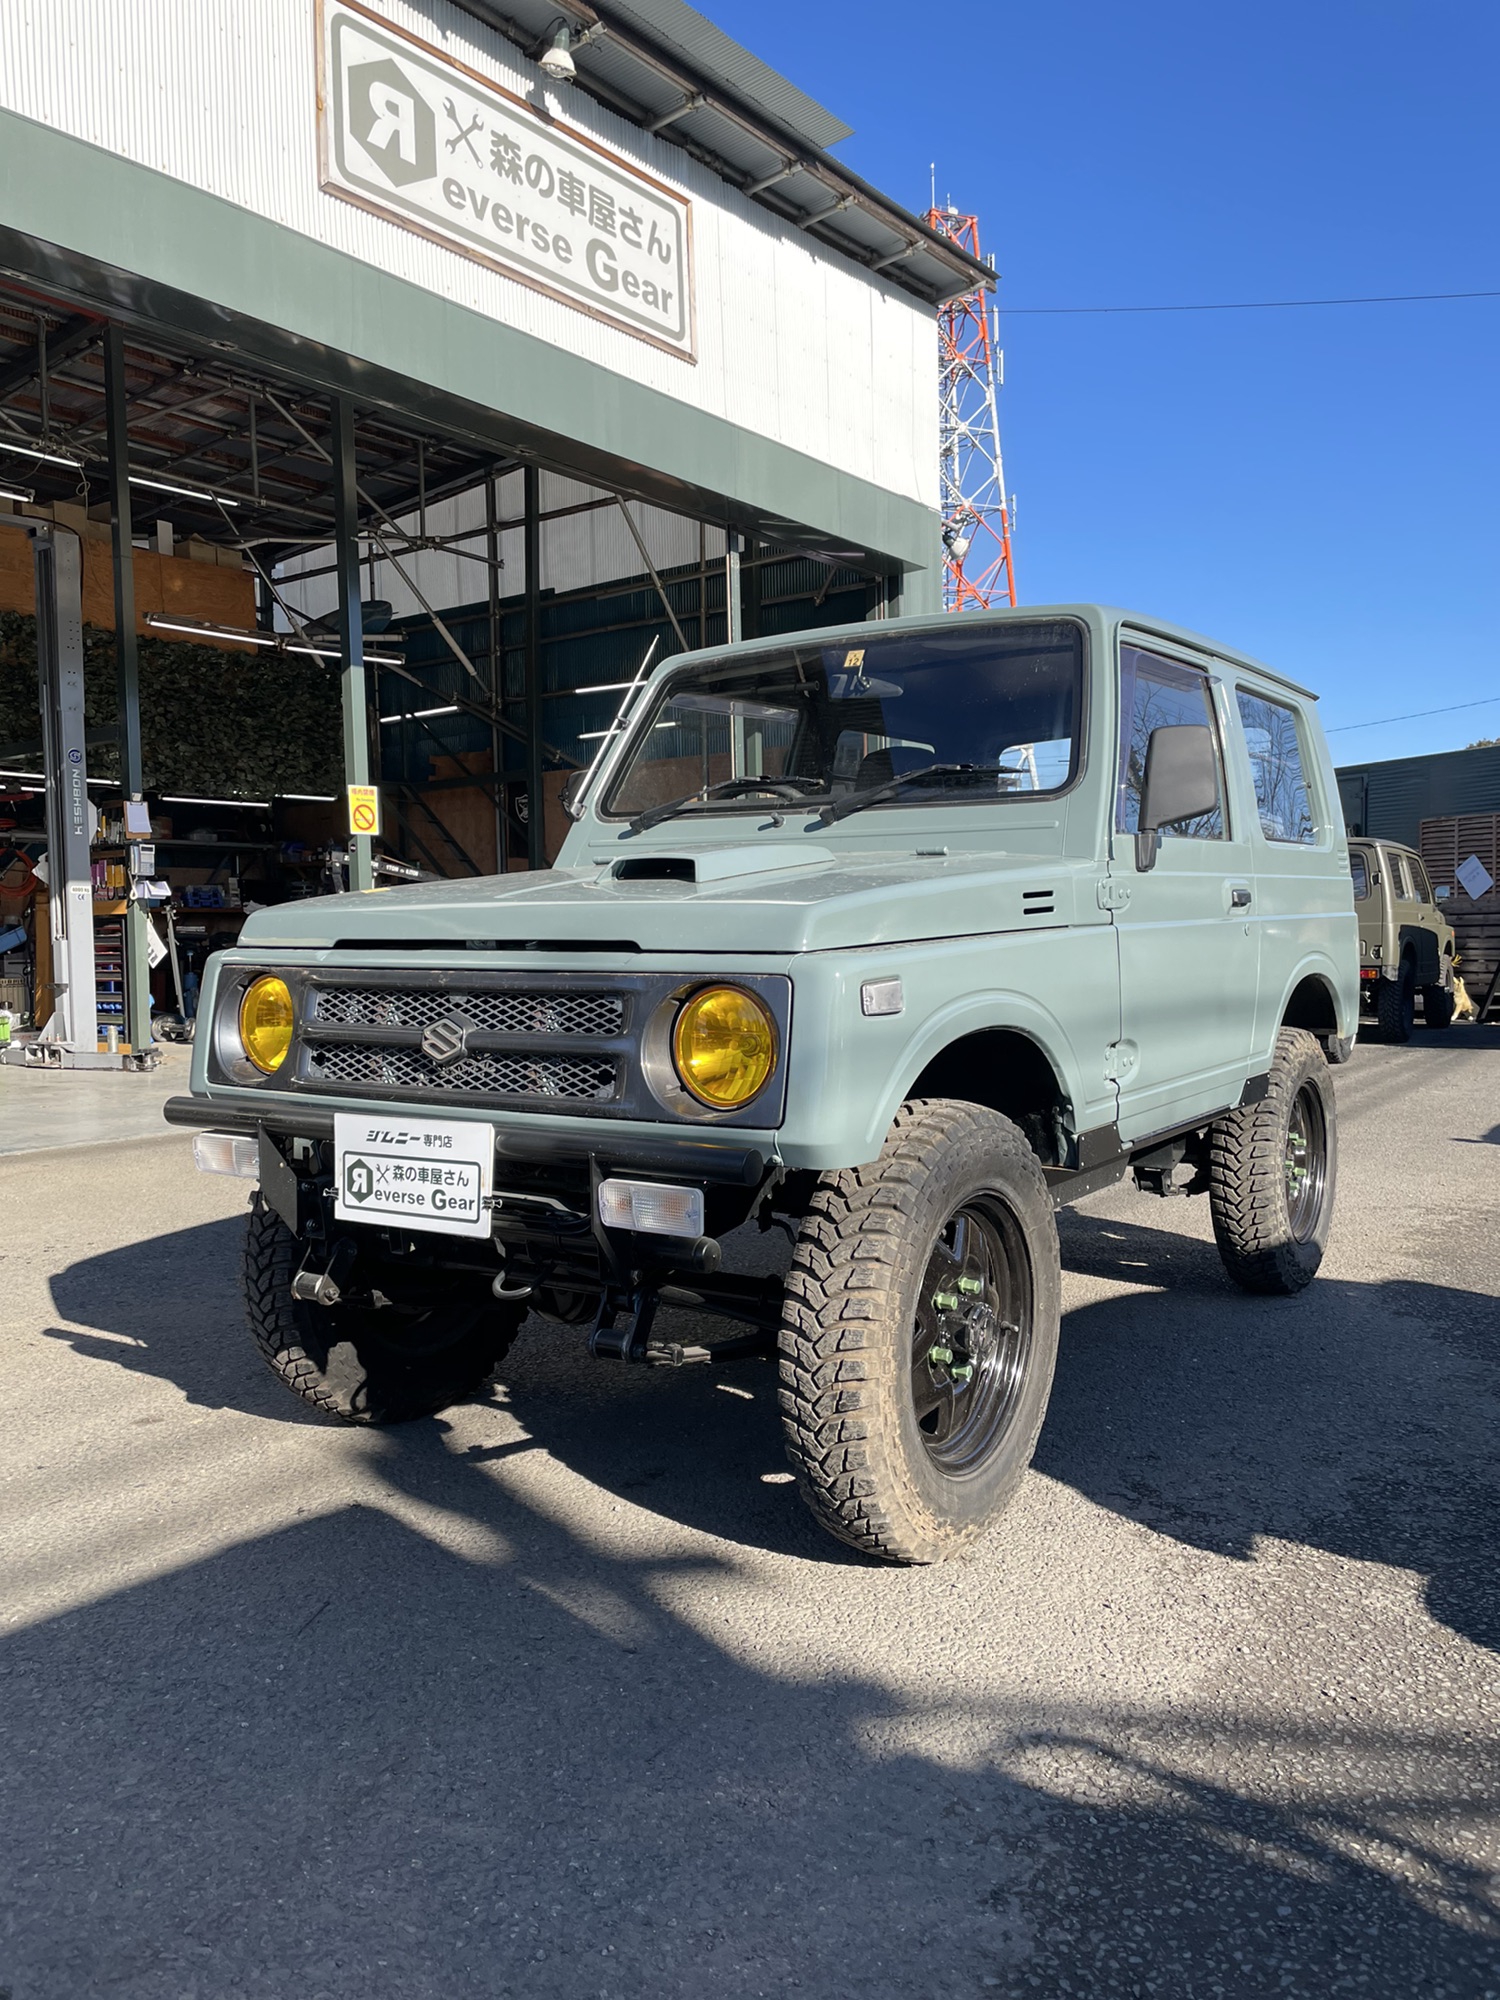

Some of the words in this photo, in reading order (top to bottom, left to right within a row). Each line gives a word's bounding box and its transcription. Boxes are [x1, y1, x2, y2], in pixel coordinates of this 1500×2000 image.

[489, 128, 672, 265] 森の車屋さん
[585, 238, 674, 315] Gear
[72, 769, 83, 835] HESHBON
[392, 1164, 470, 1188] 森の車屋さん
[431, 1188, 476, 1211] Gear
